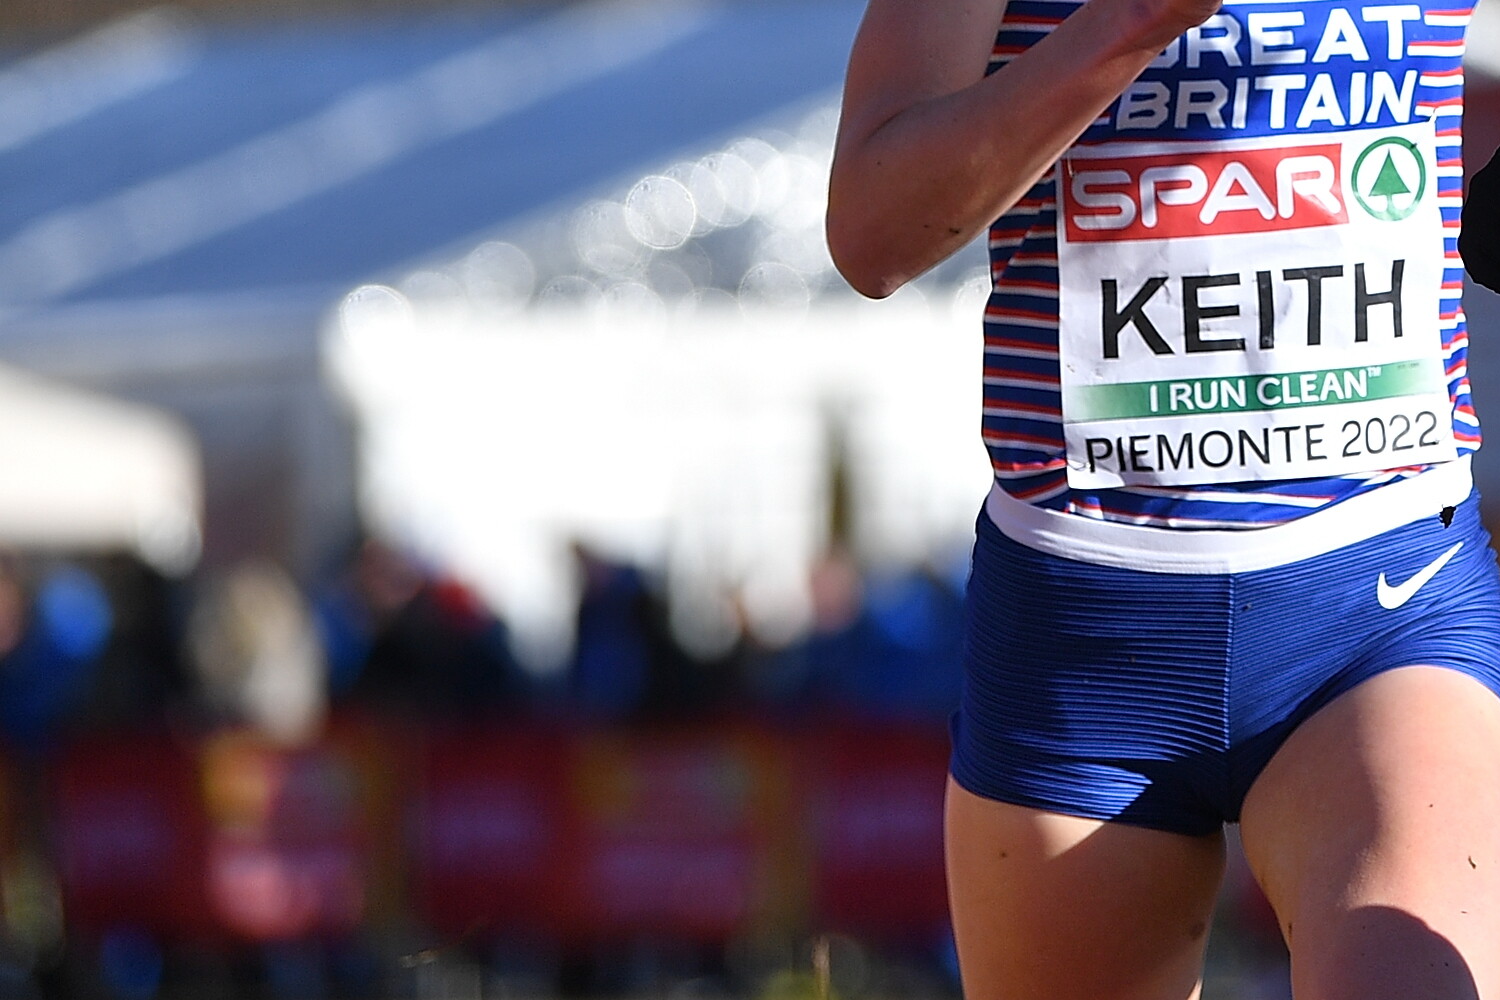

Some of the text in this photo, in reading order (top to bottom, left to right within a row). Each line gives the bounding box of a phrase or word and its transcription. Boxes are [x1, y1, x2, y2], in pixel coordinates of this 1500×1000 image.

[1115, 69, 1418, 131] BRITAIN
[1069, 154, 1343, 232] SPAR
[1099, 258, 1405, 360] KEITH
[1150, 384, 1159, 412] I
[1170, 380, 1246, 411] RUN
[1084, 410, 1440, 473] PIEMONTE 2022
